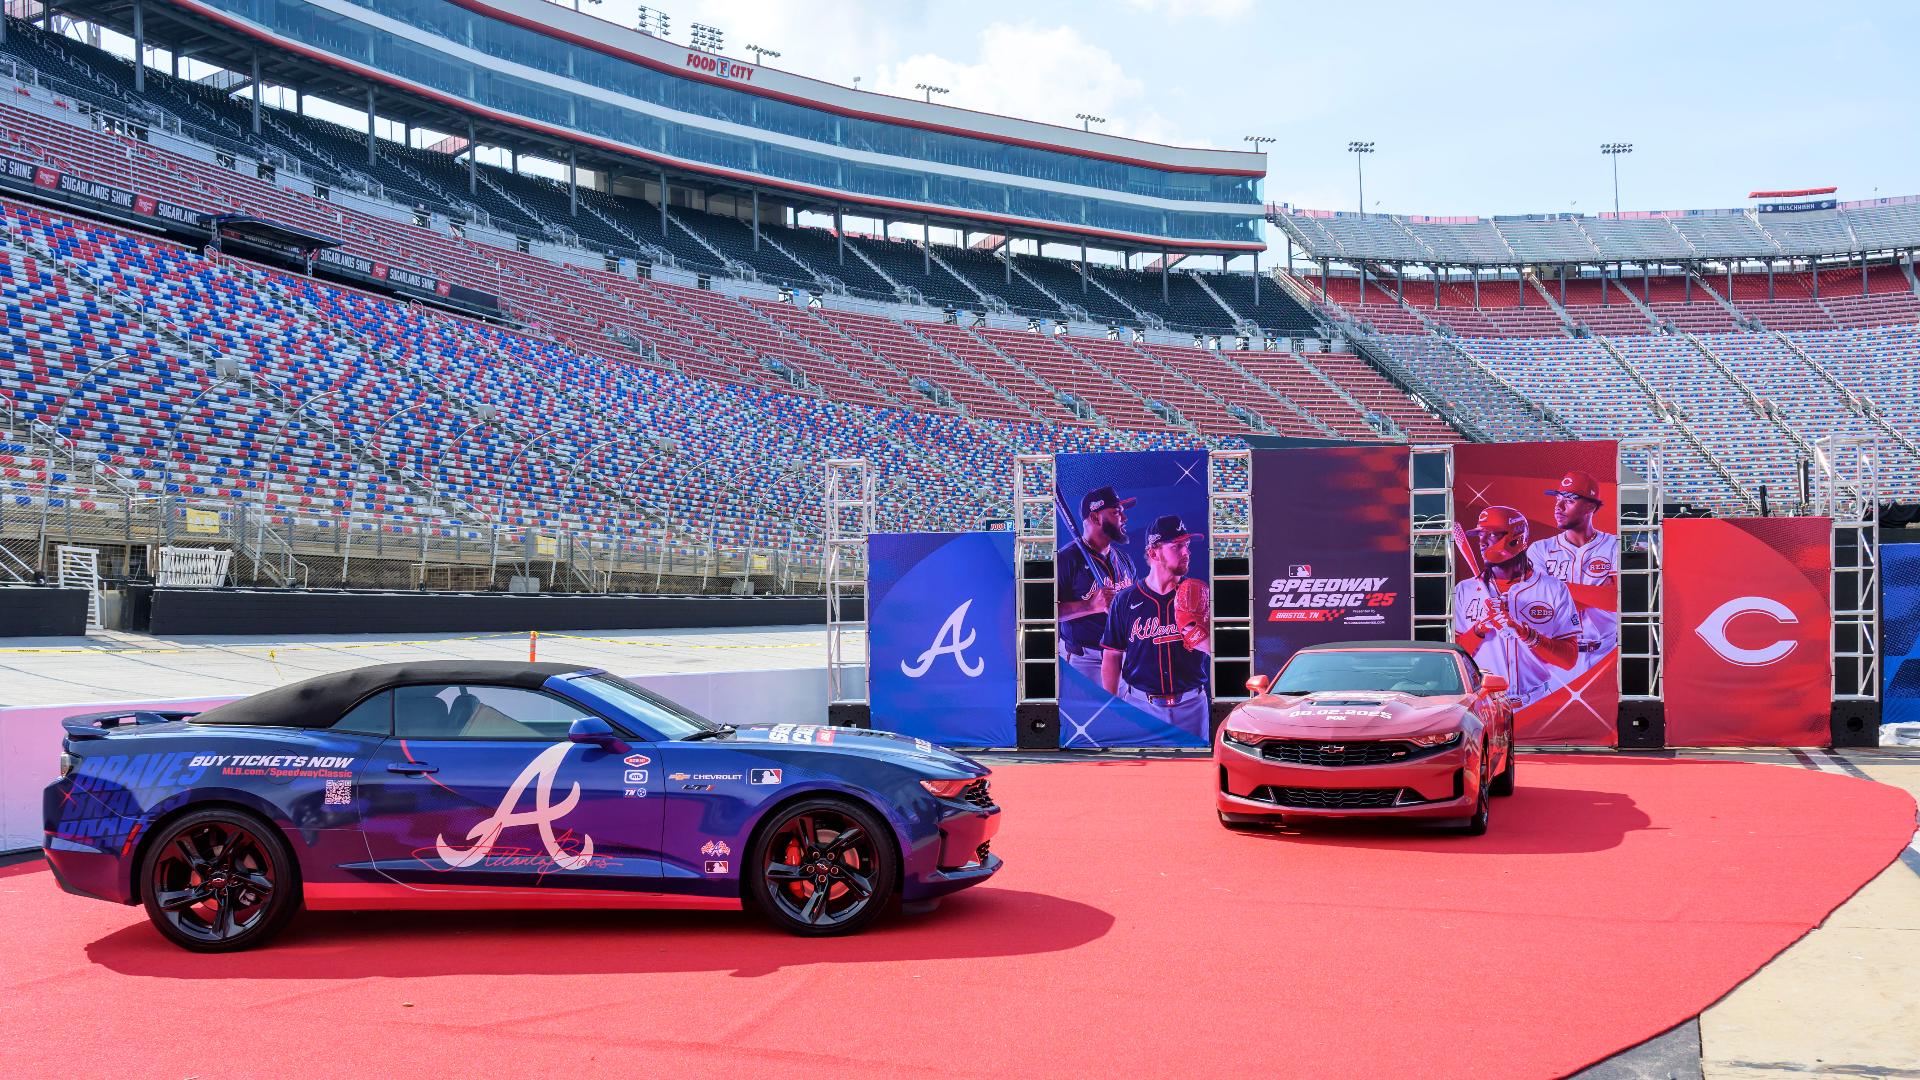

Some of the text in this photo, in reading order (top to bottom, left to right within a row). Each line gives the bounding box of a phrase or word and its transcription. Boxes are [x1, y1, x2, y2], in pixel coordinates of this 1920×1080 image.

[687, 53, 716, 71] FOOD
[730, 64, 754, 80] CITY
[9, 160, 33, 180] SHINE
[61, 175, 110, 201] SUGARLANDS
[111, 189, 133, 207] SHINE
[320, 249, 355, 269] SUGARLANDS
[1589, 563, 1611, 571] REDS
[1268, 577, 1389, 593] SPEEDWAY
[1268, 593, 1365, 608] CLASSIC
[901, 598, 985, 678] A
[1129, 616, 1178, 642] Atlan
[1694, 596, 1799, 667] C
[189, 755, 355, 769] BUY TICKETS NOW
[222, 767, 353, 779] MLB.com/SpeedwayClassic
[436, 741, 594, 870] A
